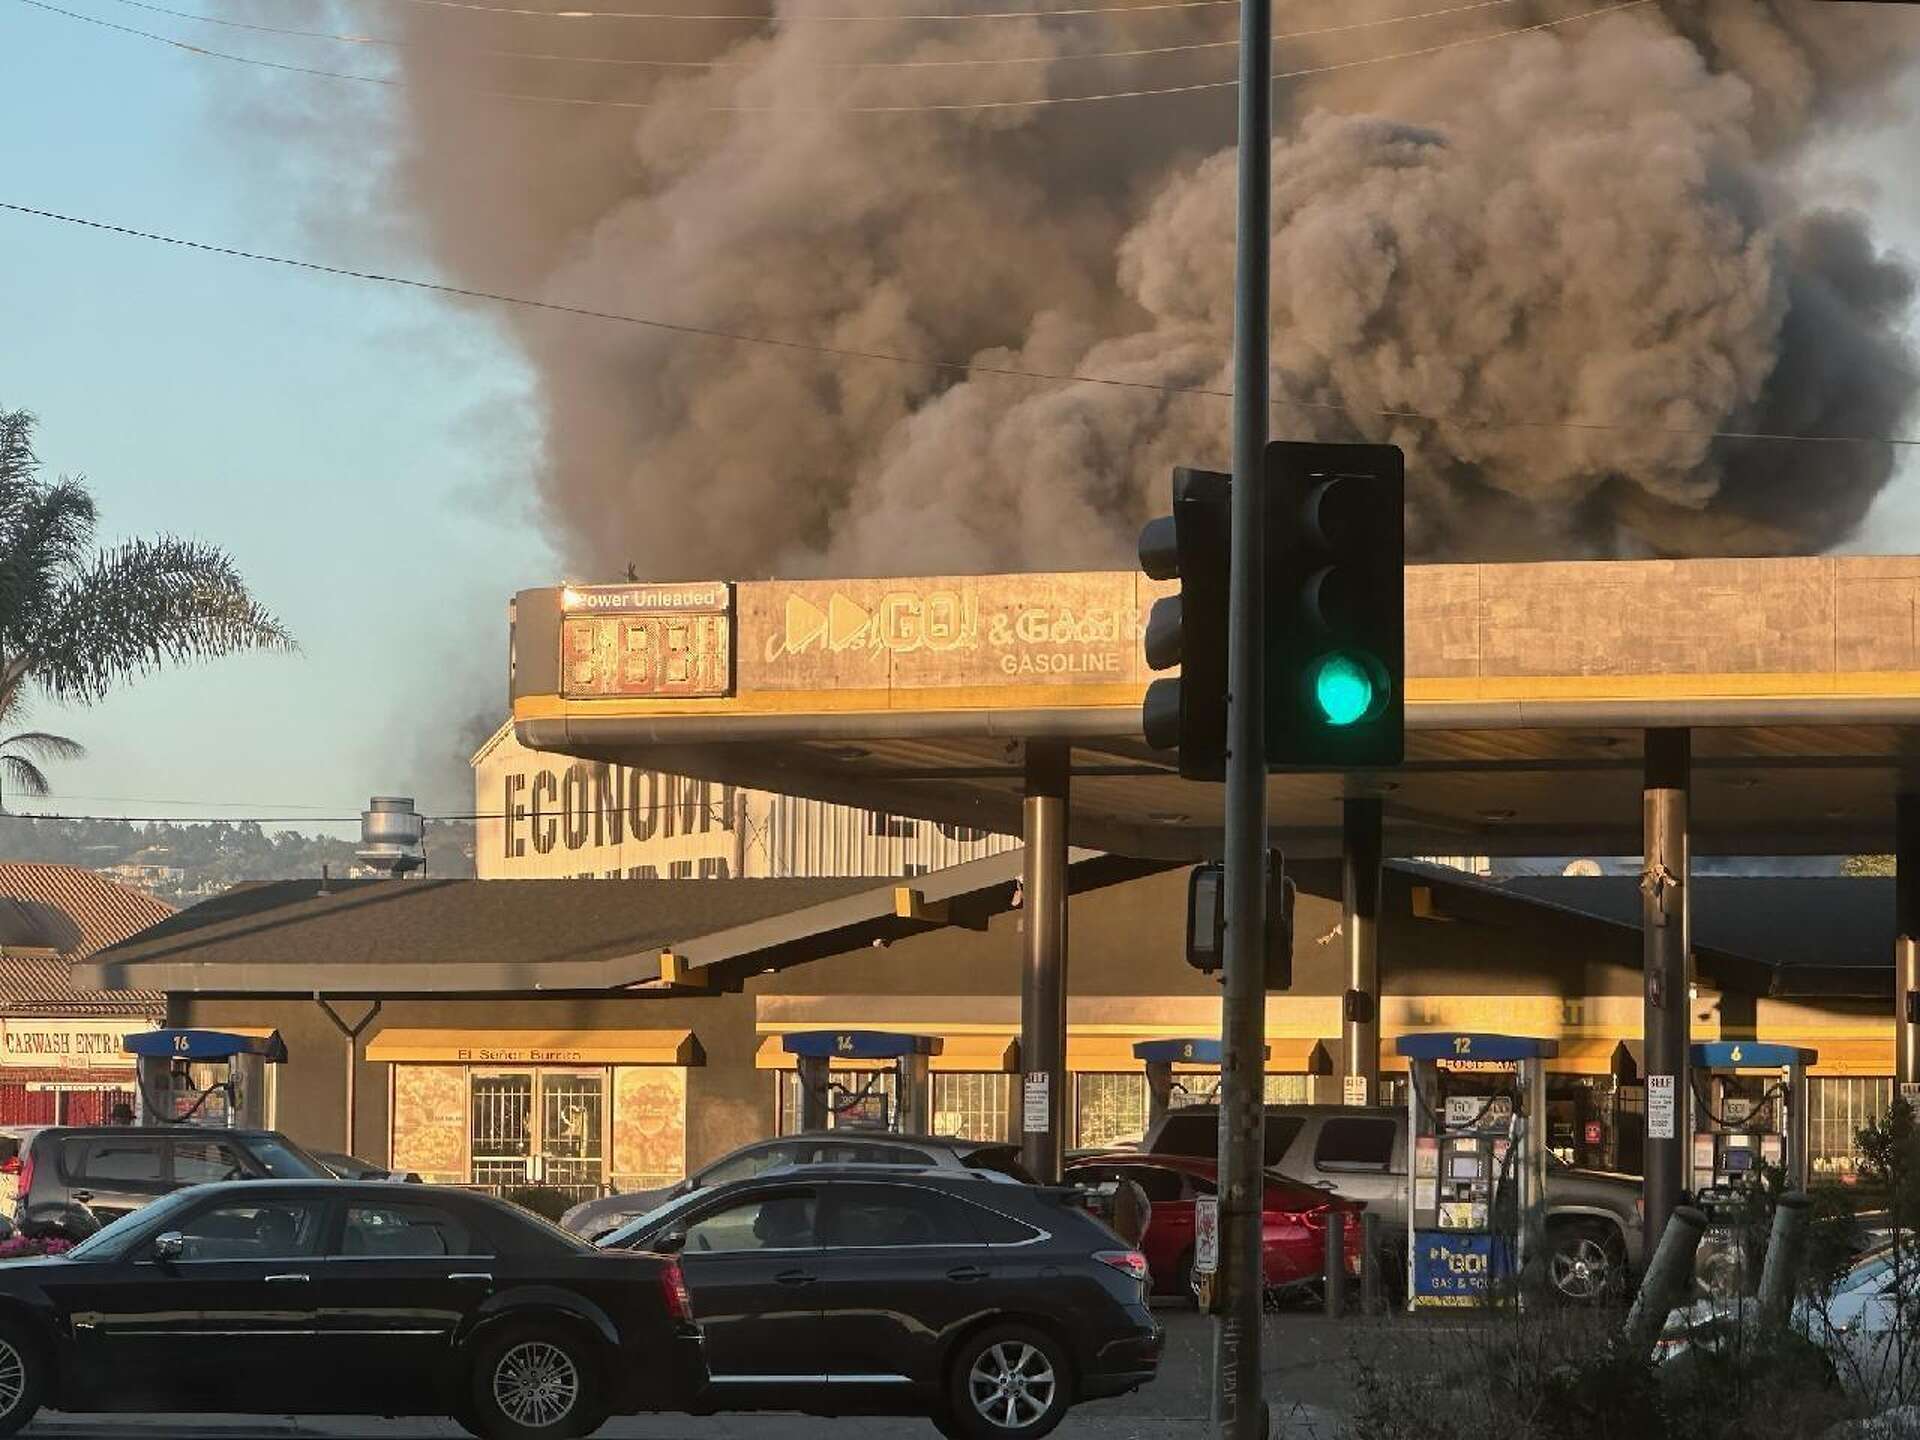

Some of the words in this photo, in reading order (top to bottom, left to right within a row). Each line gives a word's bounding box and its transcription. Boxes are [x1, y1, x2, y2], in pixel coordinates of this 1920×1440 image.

[577, 592, 629, 607] Power
[634, 590, 715, 607] Unleaded
[1001, 653, 1120, 673] GASOLINE
[6, 1033, 70, 1053] CARWASH
[75, 1033, 124, 1053] ENTRA
[837, 1035, 853, 1050] 14
[1453, 1037, 1471, 1054] 12
[457, 1049, 472, 1060] El
[1731, 1046, 1742, 1061] 6
[1431, 1278, 1453, 1289] GAS
